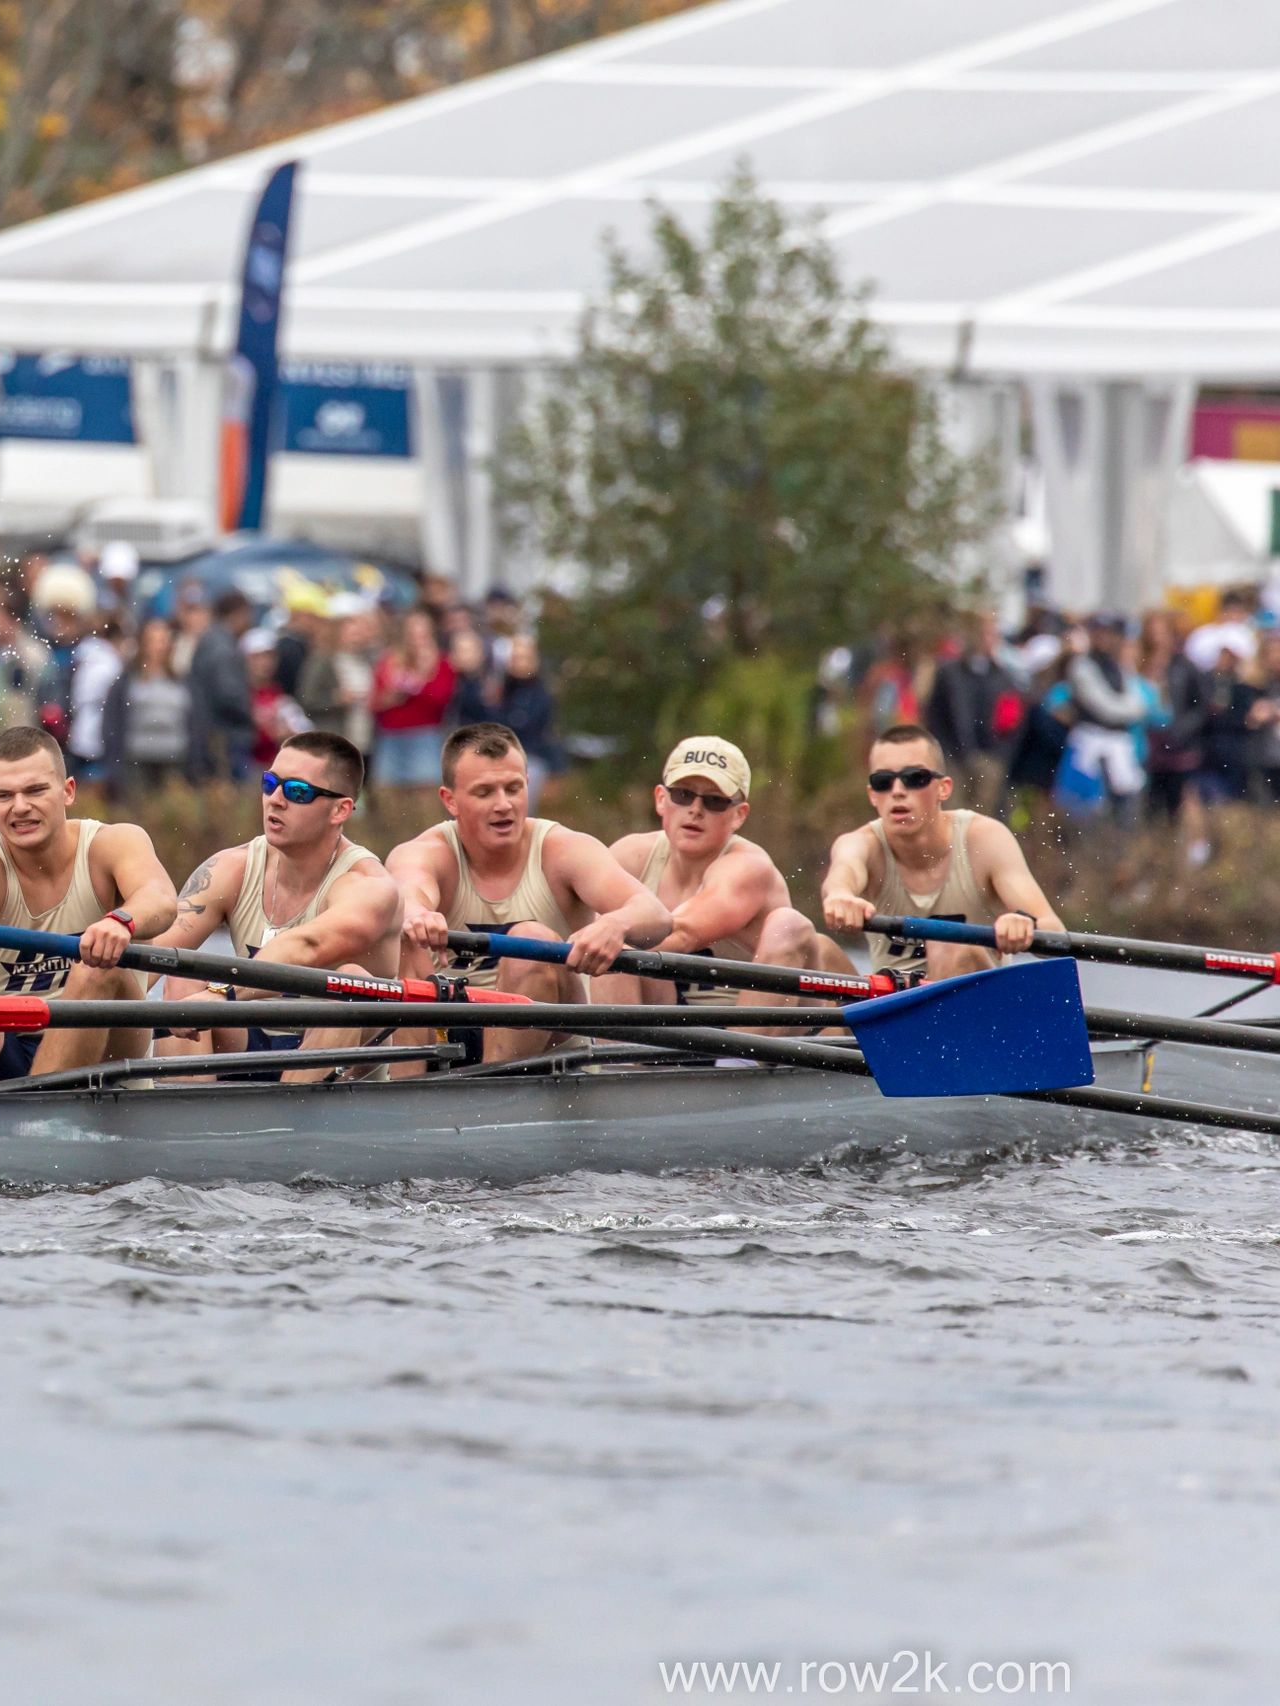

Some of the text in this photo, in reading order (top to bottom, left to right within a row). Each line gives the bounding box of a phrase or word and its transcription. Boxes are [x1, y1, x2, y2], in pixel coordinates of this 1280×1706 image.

[684, 750, 728, 769] BUCS
[1204, 952, 1275, 969] DREHER
[326, 975, 403, 994] DREHER
[799, 975, 870, 990] DREHER
